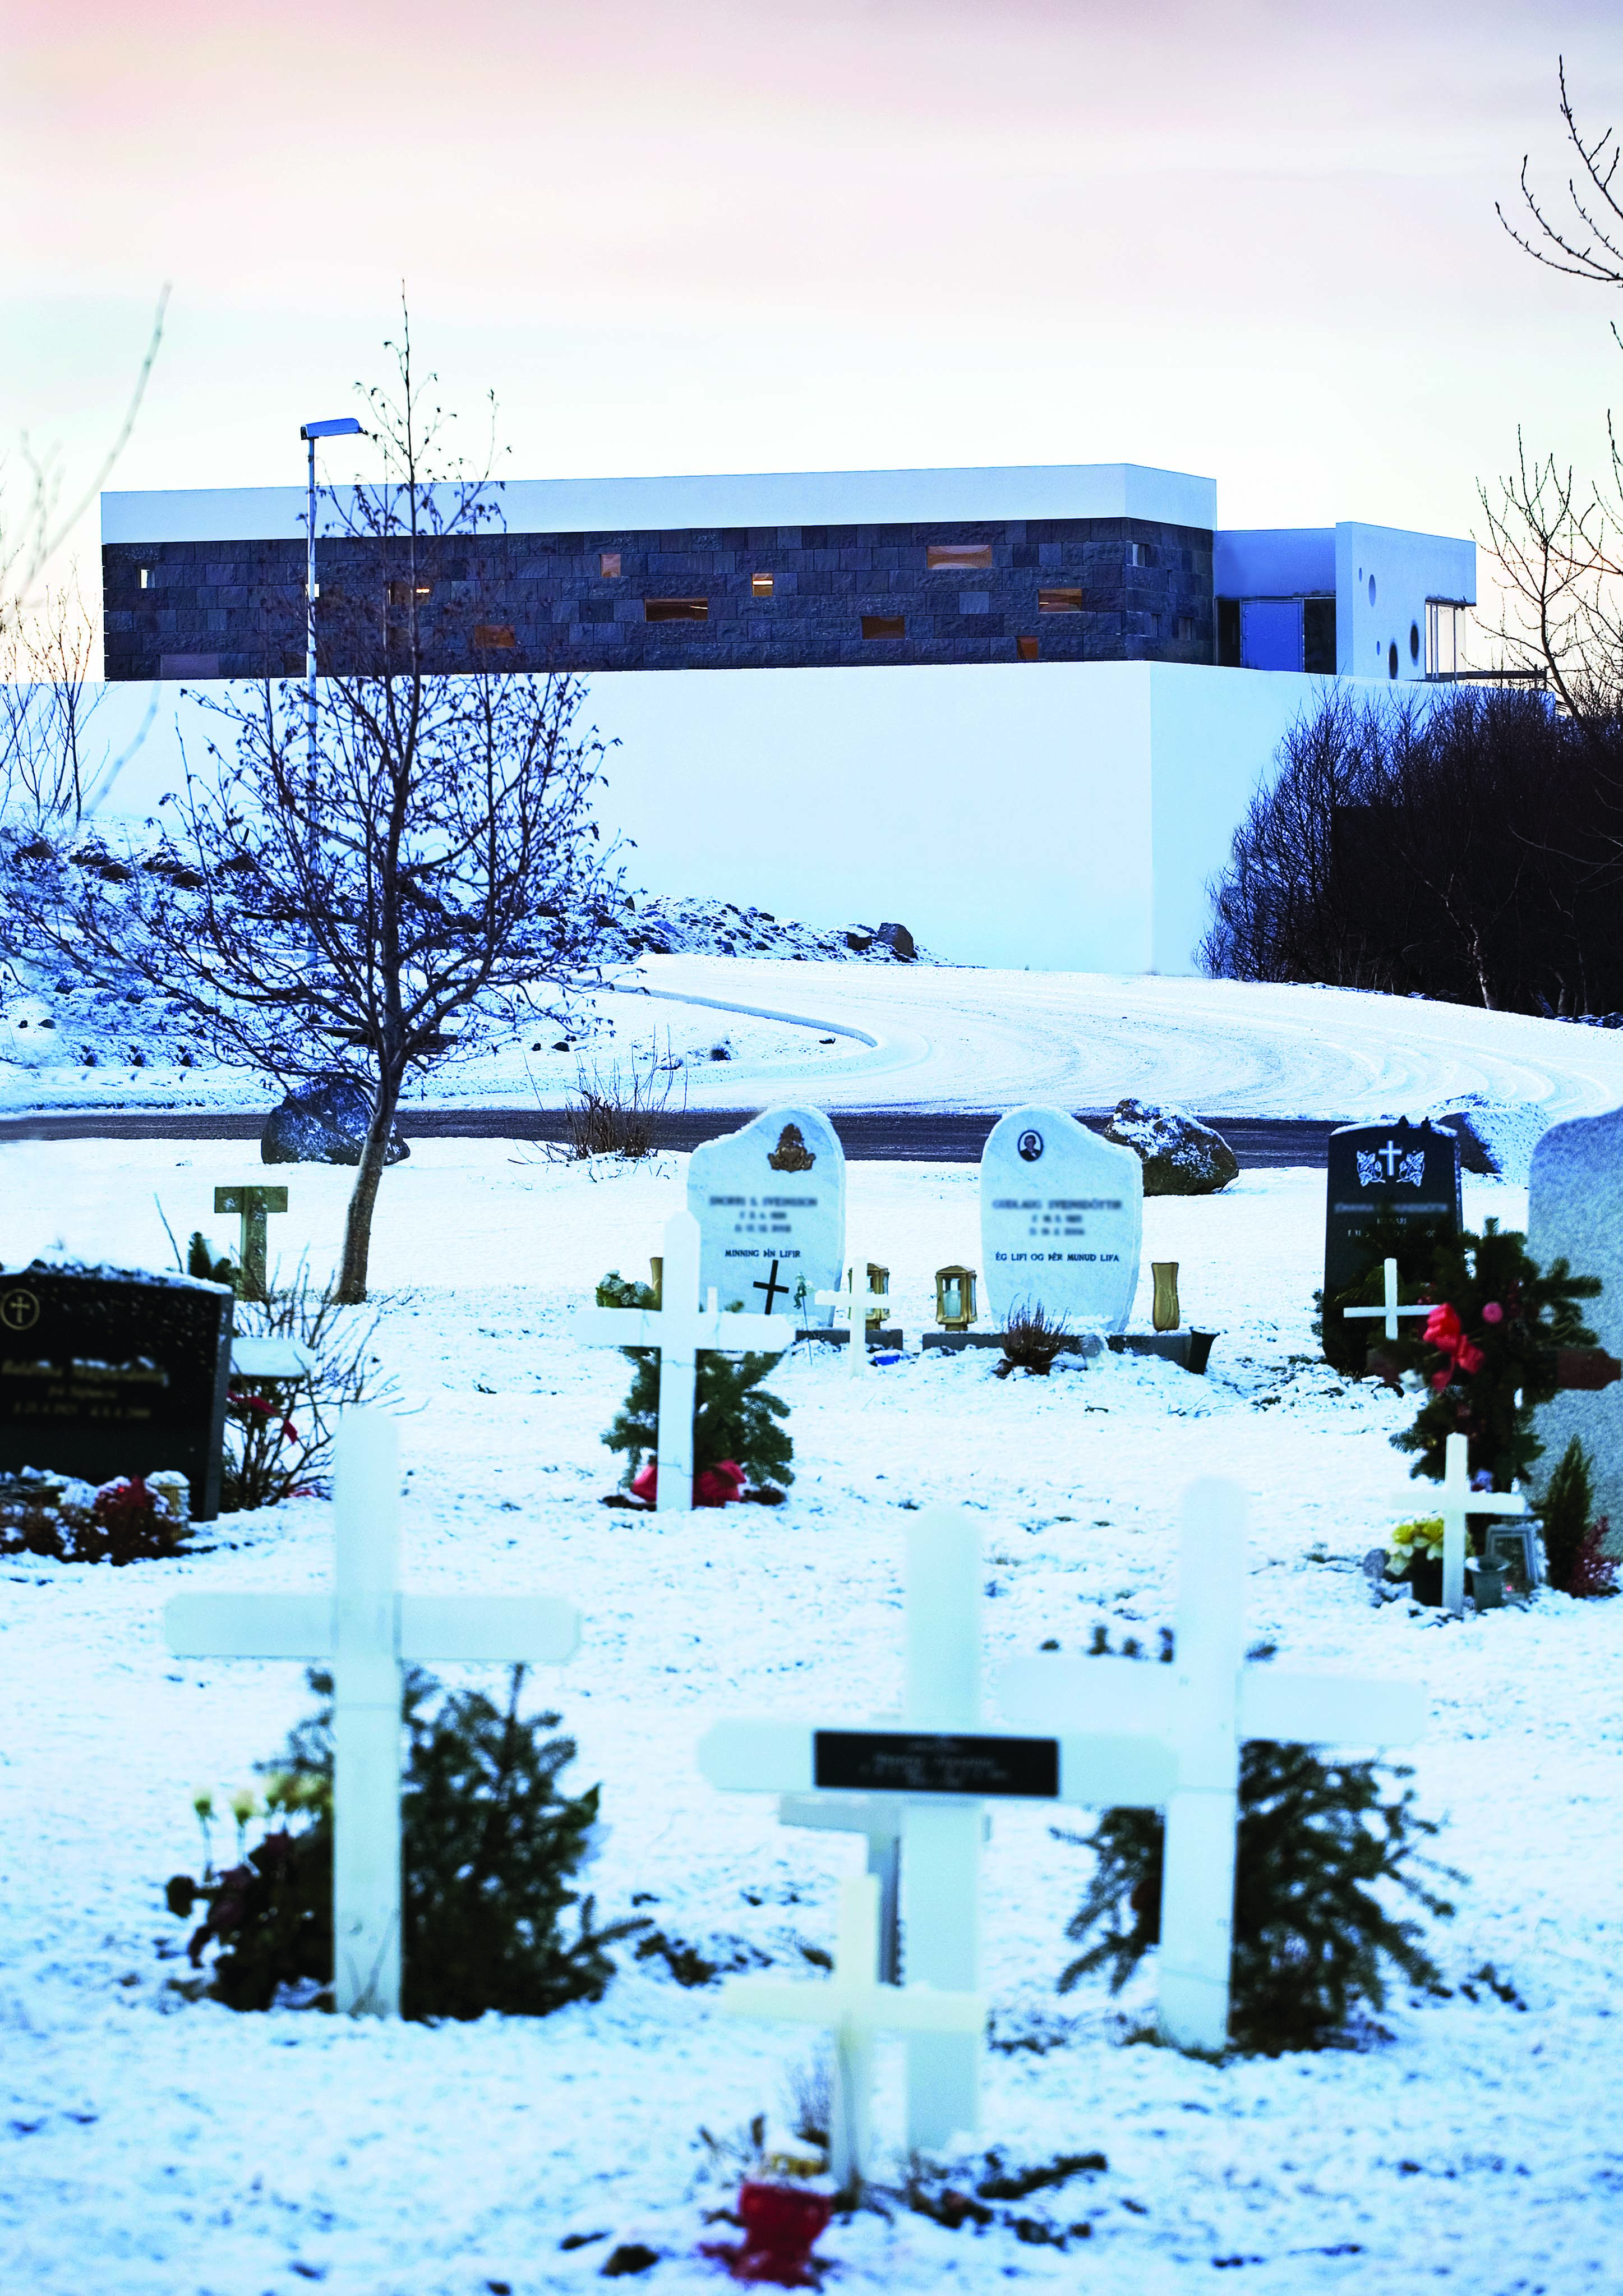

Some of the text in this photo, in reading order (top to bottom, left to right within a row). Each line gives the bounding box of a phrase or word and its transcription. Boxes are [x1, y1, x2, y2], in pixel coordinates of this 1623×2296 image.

[725, 1249, 760, 1258] MINNING
[779, 1250, 801, 1258] LIFIR
[1100, 1254, 1120, 1262] LIFA
